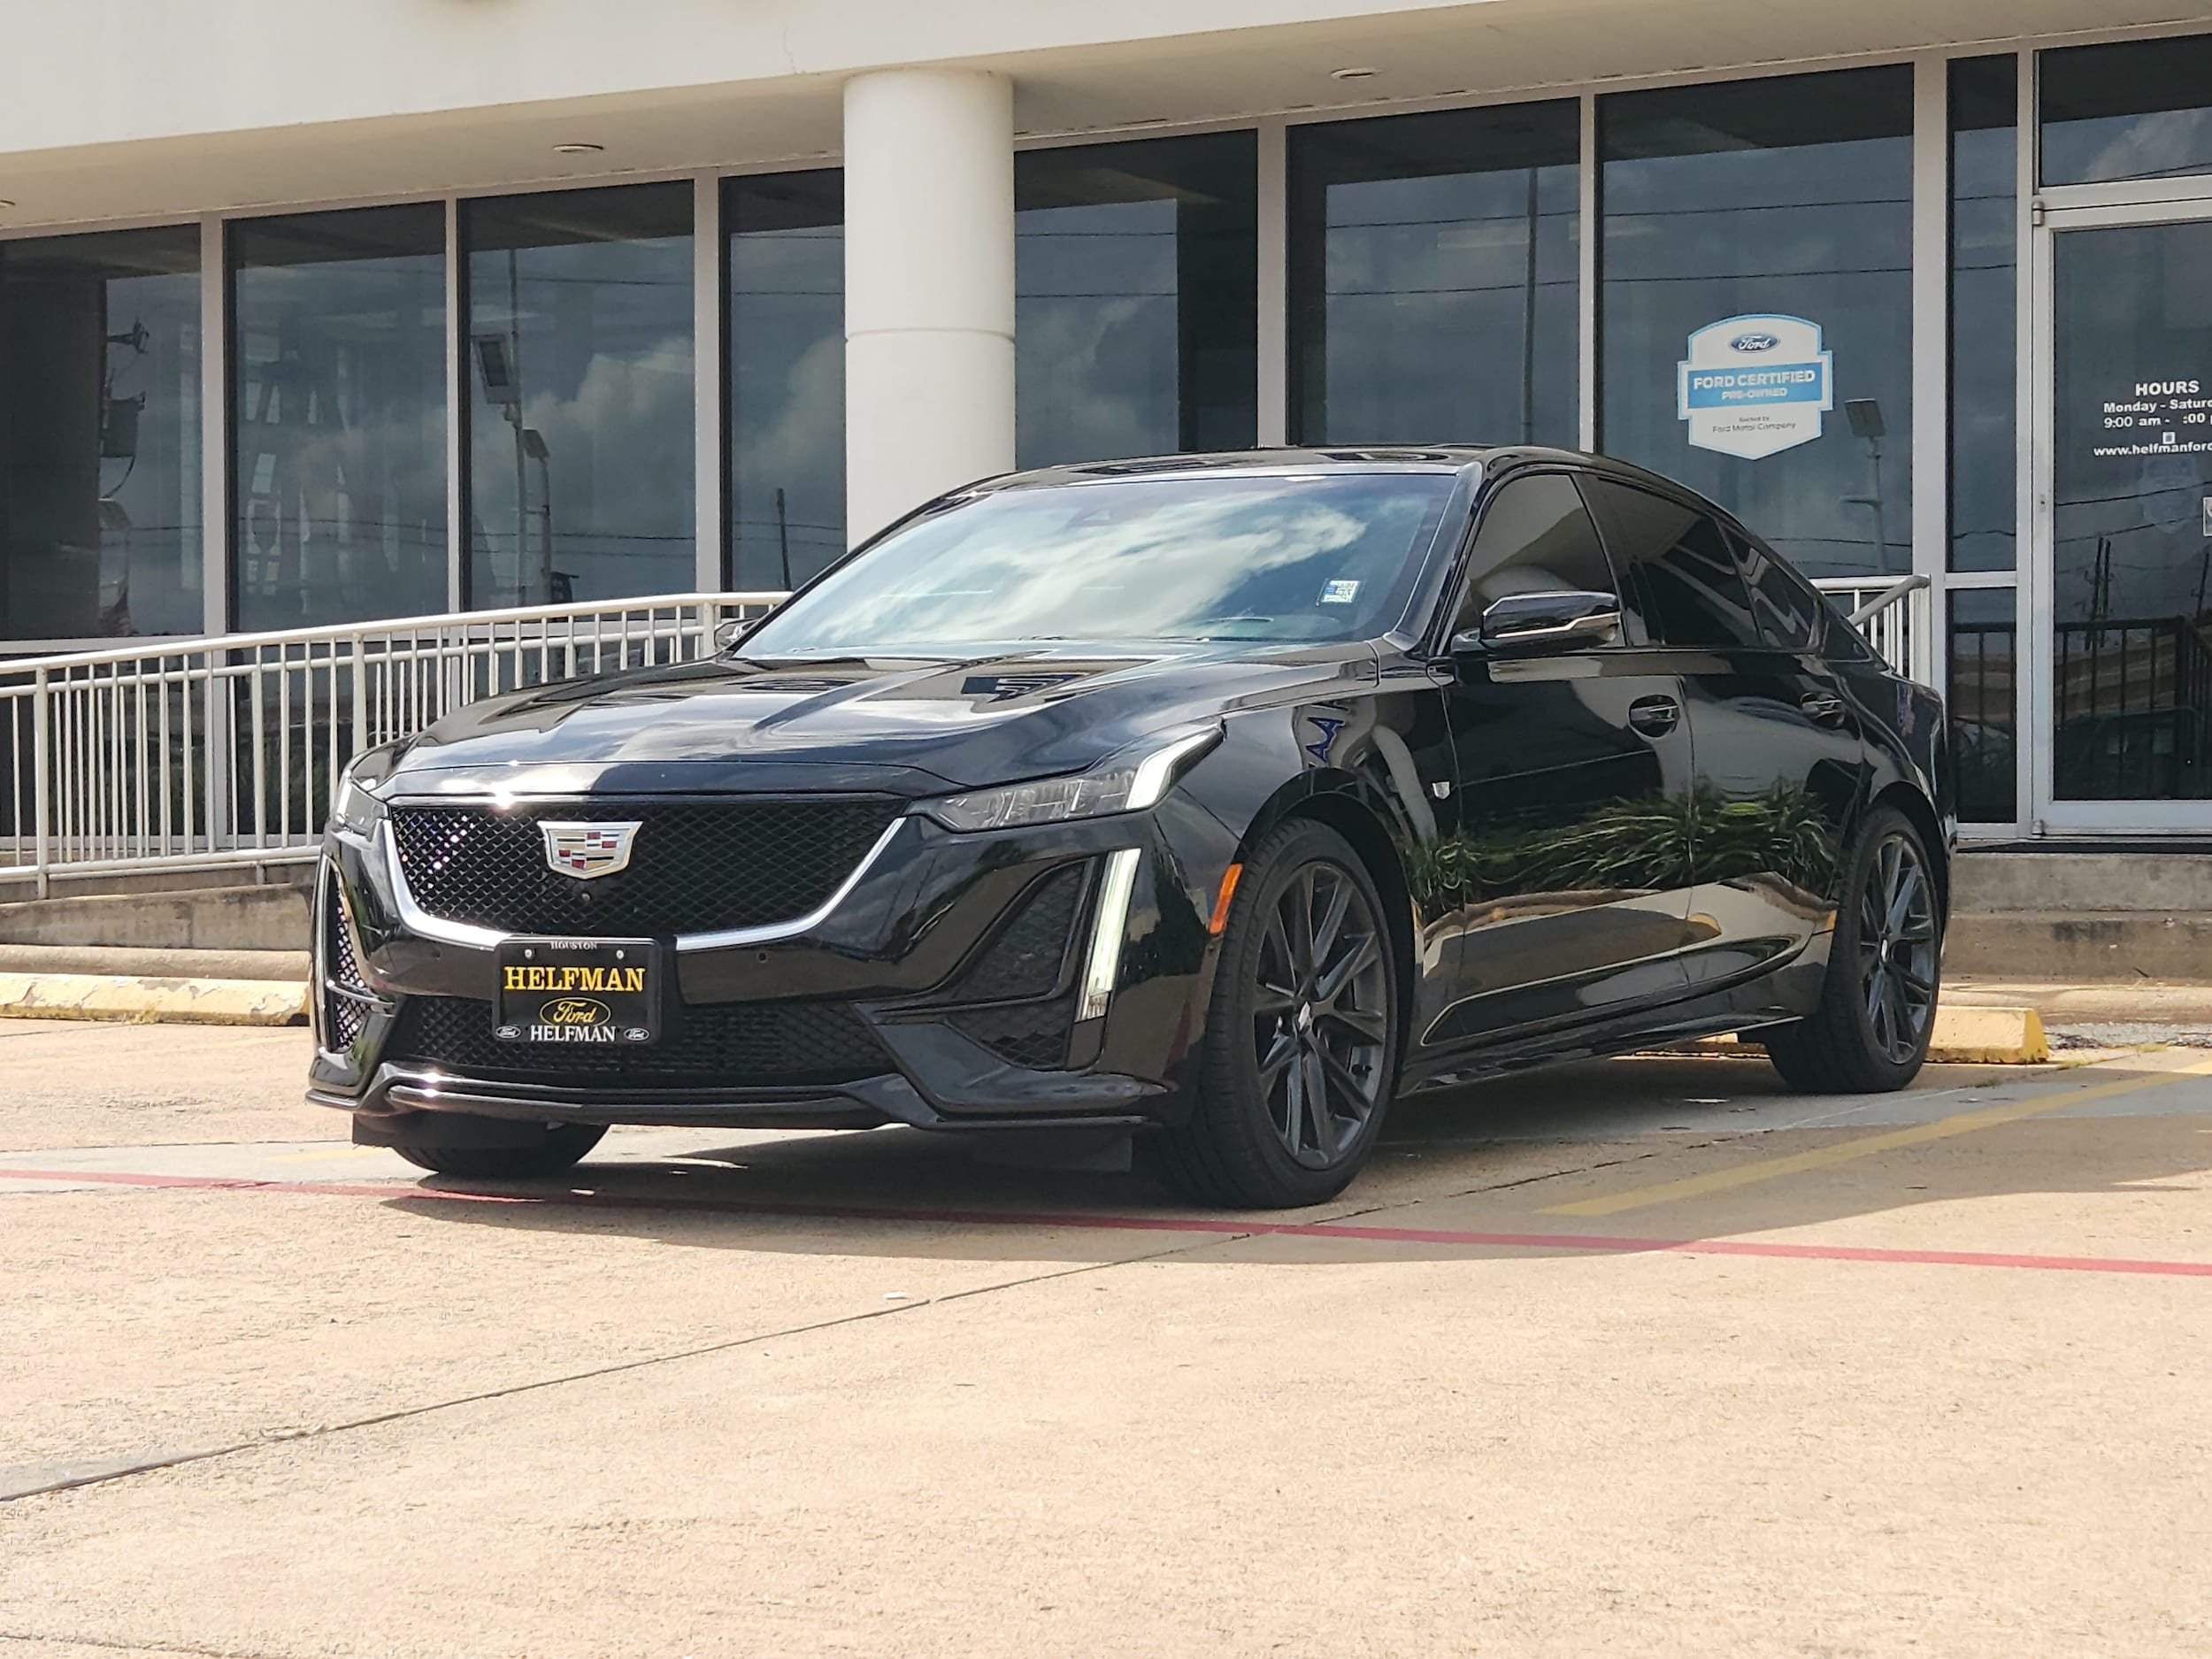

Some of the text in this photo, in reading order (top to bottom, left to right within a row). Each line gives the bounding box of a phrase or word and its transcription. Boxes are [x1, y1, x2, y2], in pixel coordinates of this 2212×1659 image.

[1738, 334, 1770, 350] Ford
[1694, 370, 1816, 390] FORD CERTIFIED
[2135, 380, 2200, 396] HOURS
[2103, 402, 2157, 414] Monday
[2103, 417, 2133, 429] 9:00
[2138, 417, 2162, 426] am
[550, 941, 598, 950] HOUSTON
[503, 966, 646, 992] HELFMAN
[553, 1000, 597, 1024] Ford
[530, 1025, 617, 1042] HELFMAN
